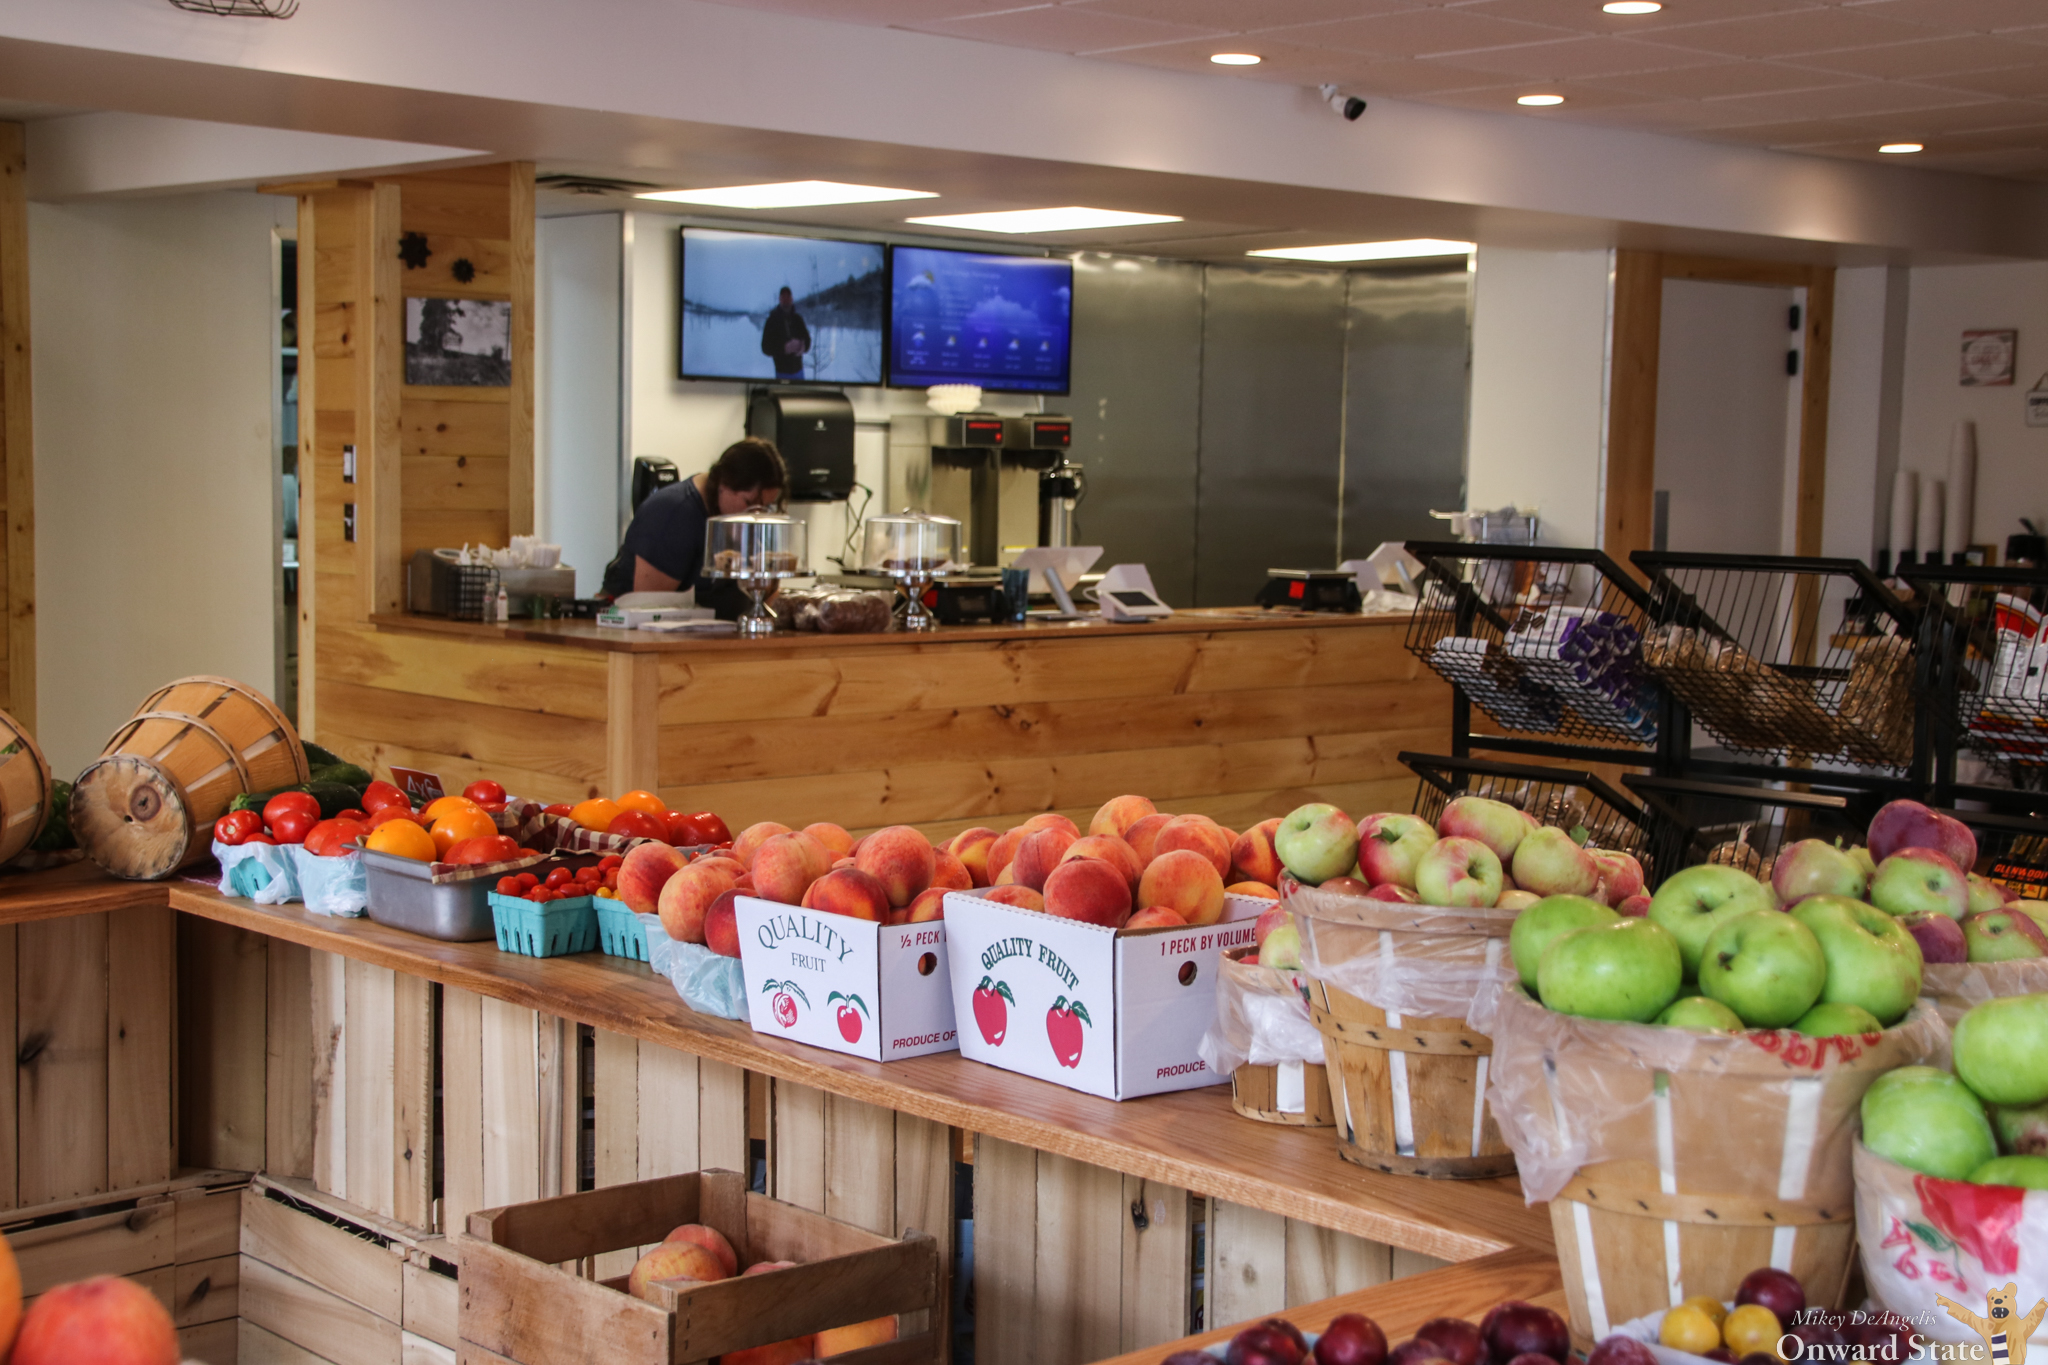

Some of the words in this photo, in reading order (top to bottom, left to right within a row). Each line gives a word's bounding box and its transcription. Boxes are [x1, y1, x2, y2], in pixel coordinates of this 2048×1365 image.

[758, 914, 854, 964] QUALITY
[916, 930, 940, 946] PECK
[1161, 941, 1166, 956] 1
[1170, 937, 1197, 955] PECK
[1200, 934, 1214, 951] BY
[1217, 927, 1256, 948] VOLUME
[791, 952, 826, 972] FRUIT
[981, 937, 1033, 970] QUALITY
[1038, 943, 1079, 991] FRUIT
[893, 1033, 940, 1049] PRODUCE
[942, 1030, 957, 1042] OF
[1156, 1060, 1206, 1079] PRODUCE
